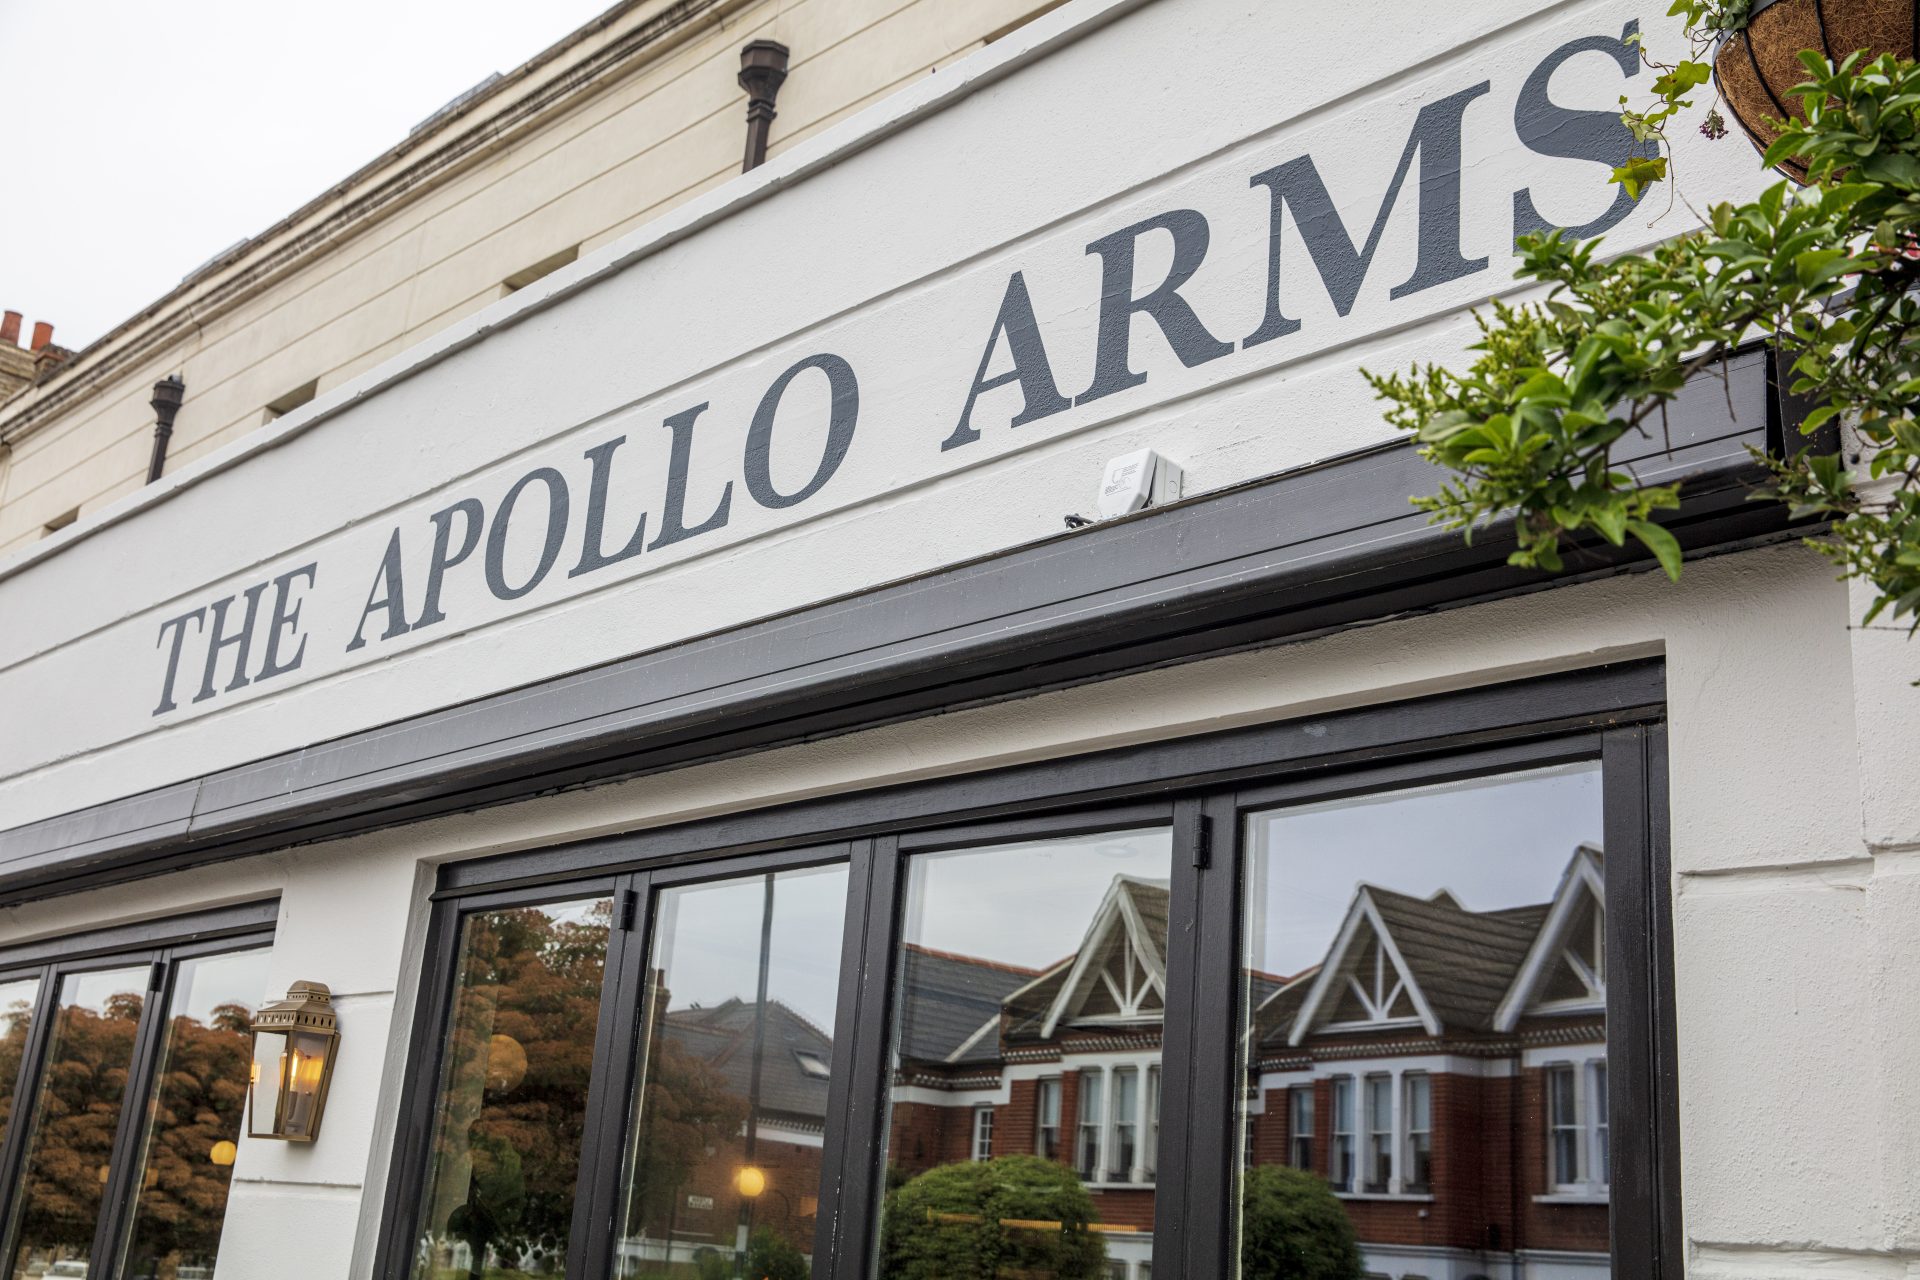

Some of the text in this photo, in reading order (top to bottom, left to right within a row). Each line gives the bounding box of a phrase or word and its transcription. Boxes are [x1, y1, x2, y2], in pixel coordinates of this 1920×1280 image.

[152, 18, 1660, 717] THE APOLLO ARMS
